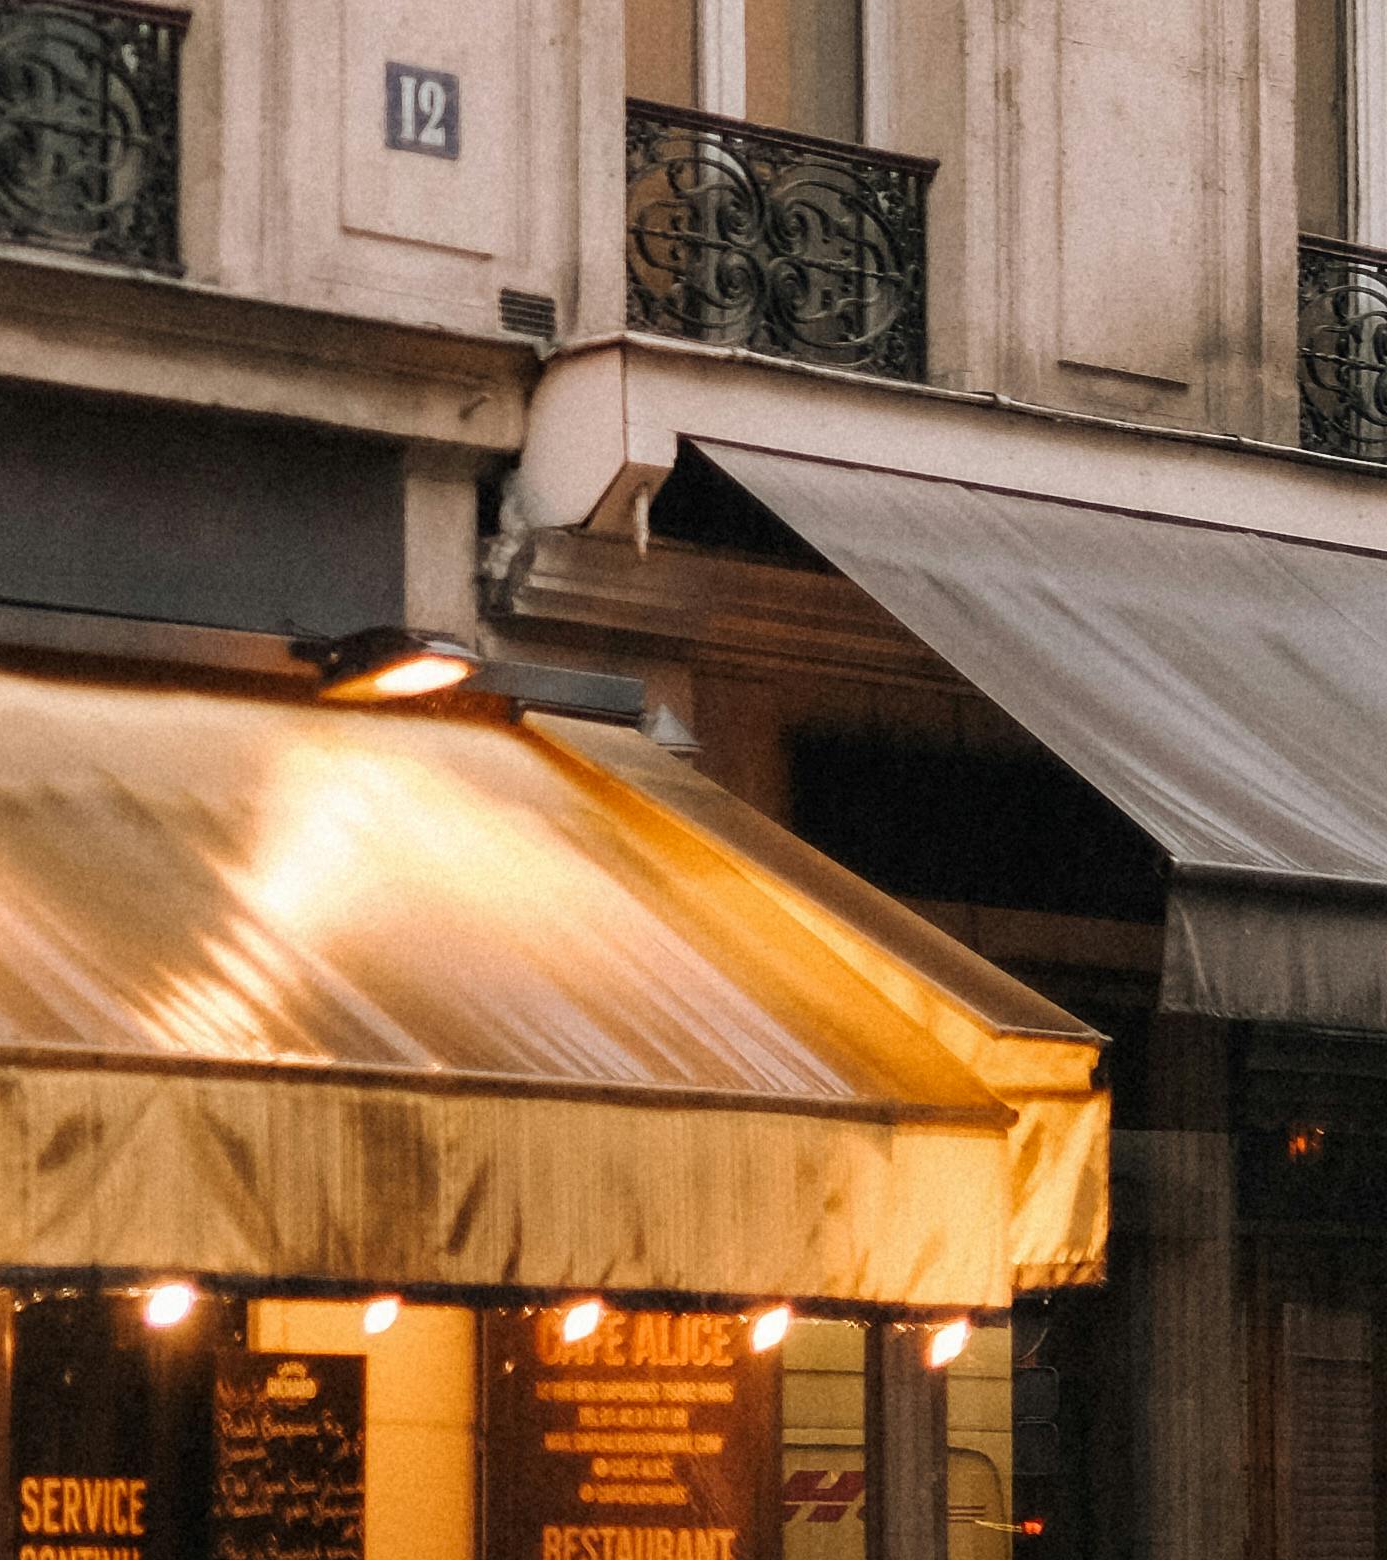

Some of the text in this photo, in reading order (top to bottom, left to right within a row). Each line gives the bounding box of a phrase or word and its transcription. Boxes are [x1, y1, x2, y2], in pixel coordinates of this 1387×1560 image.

[399, 75, 448, 148] 12
[634, 1312, 735, 1367] ALICE
[21, 1476, 146, 1536] SERVICE
